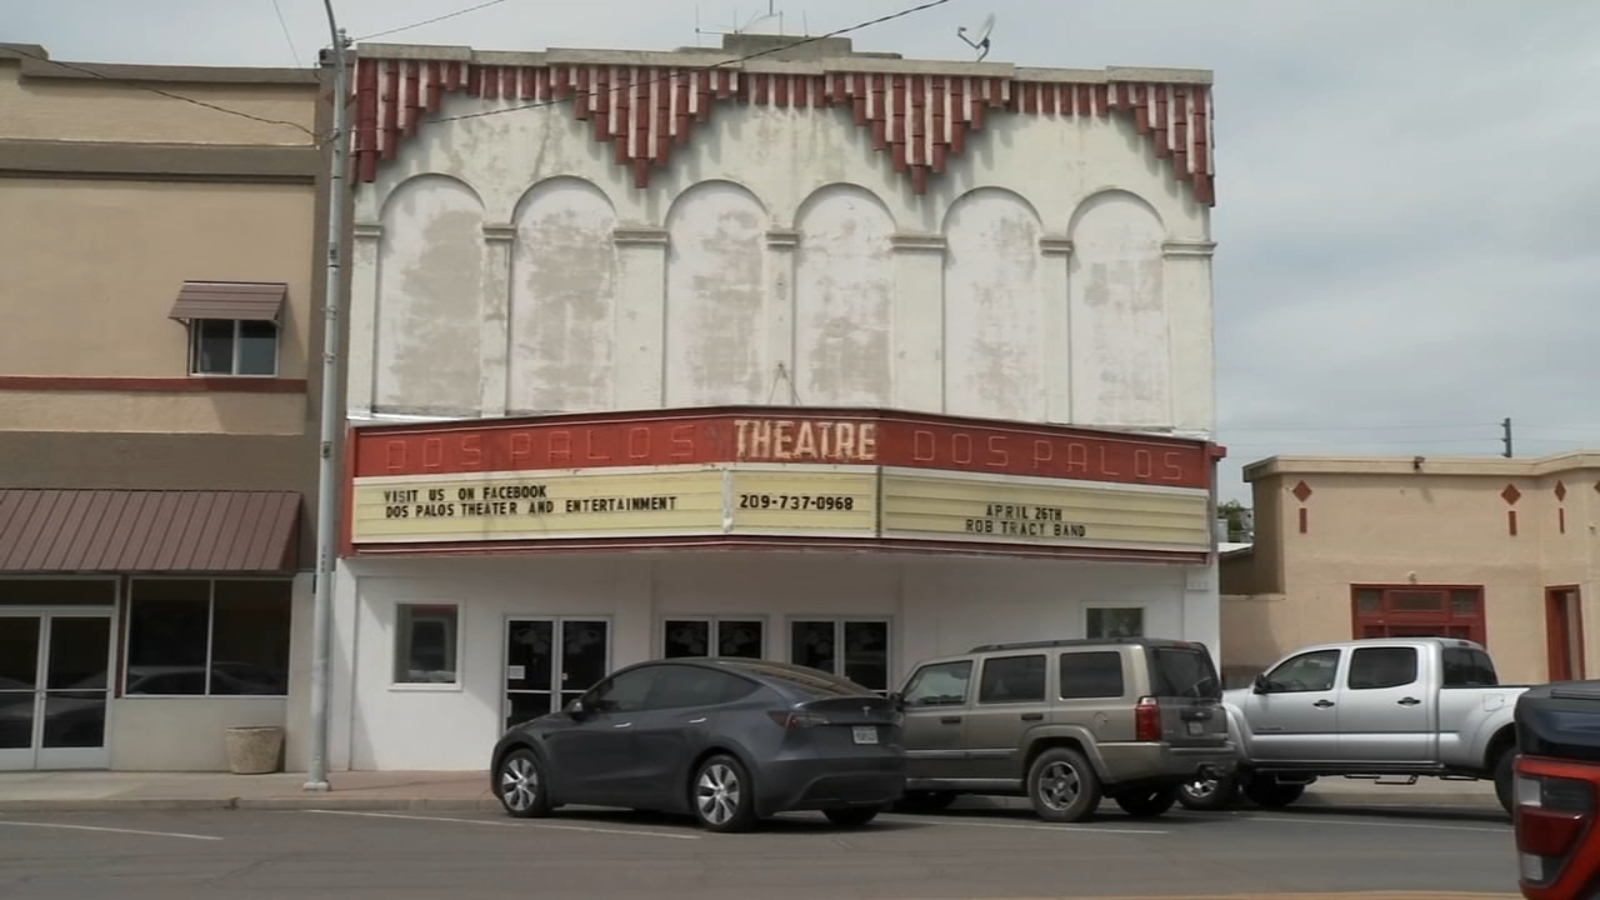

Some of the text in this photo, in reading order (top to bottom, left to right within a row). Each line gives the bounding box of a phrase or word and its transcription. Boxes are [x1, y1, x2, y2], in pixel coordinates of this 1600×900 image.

[385, 424, 695, 470] DOS PALOS
[734, 419, 877, 461] THEATRE
[914, 430, 1183, 480] DOS PALOS
[384, 485, 547, 503] VISIT US ON FACEBOOK
[740, 494, 854, 511] 209-737-0968
[385, 496, 677, 519] DOS PALOS THEATER AND ENTERTAINMENT
[985, 504, 1063, 521] APRIL 26TH
[965, 518, 994, 533] ROB
[1054, 523, 1086, 538] BAND
